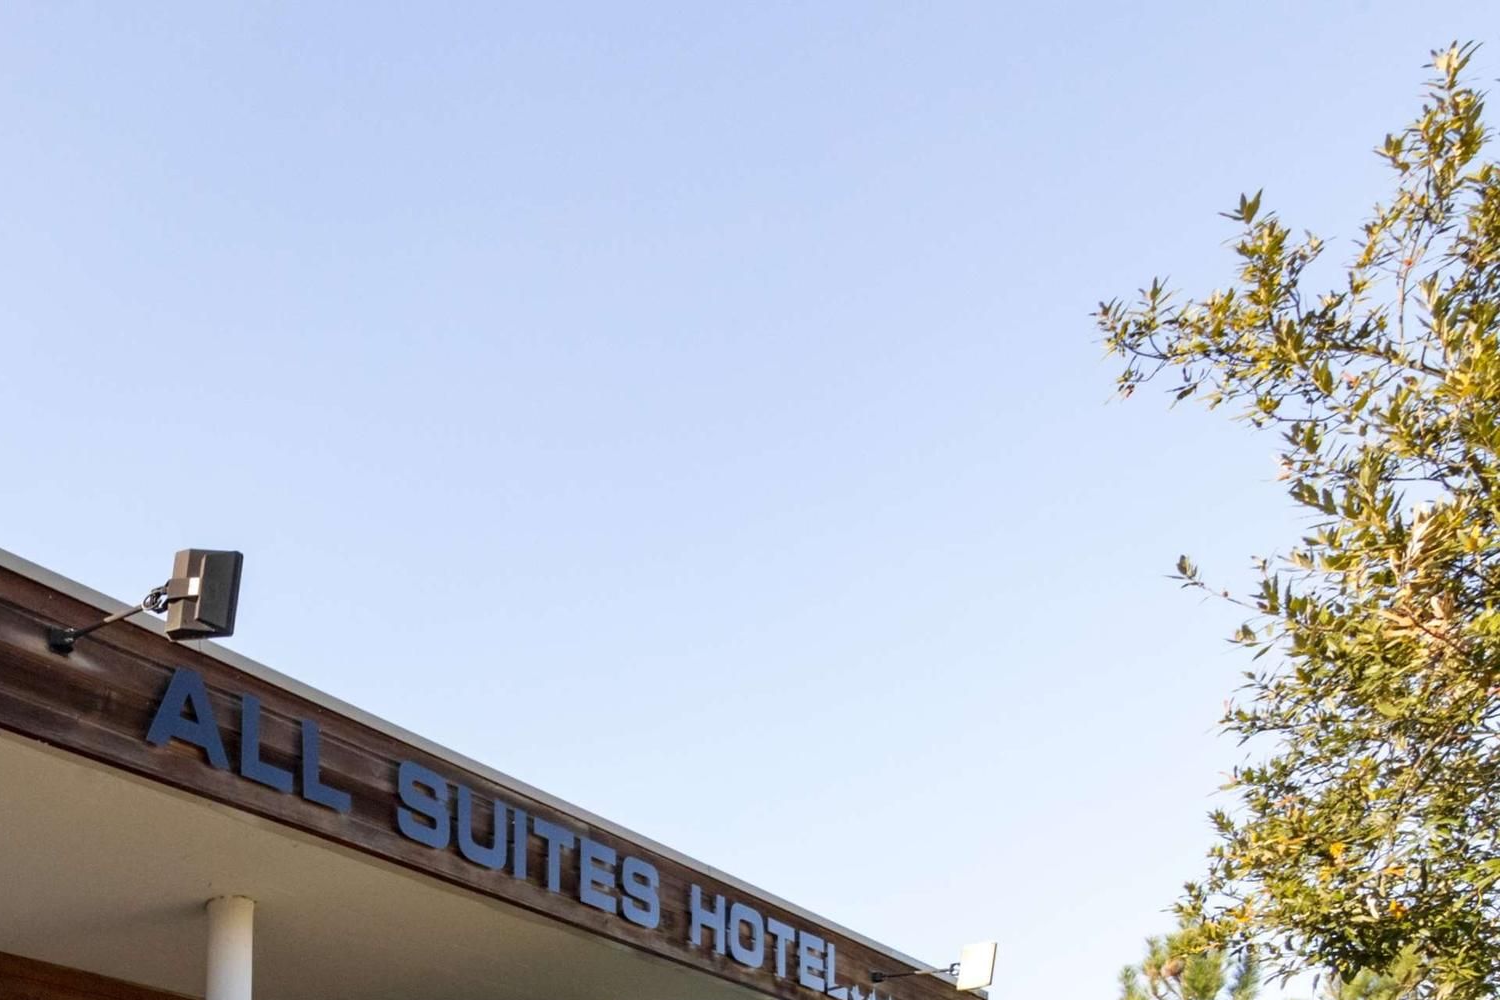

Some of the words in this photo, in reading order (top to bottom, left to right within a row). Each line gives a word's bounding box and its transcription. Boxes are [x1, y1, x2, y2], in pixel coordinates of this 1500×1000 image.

[146, 666, 350, 813] ALL
[397, 760, 660, 929] SUITES
[690, 883, 848, 1000] HOTEL
